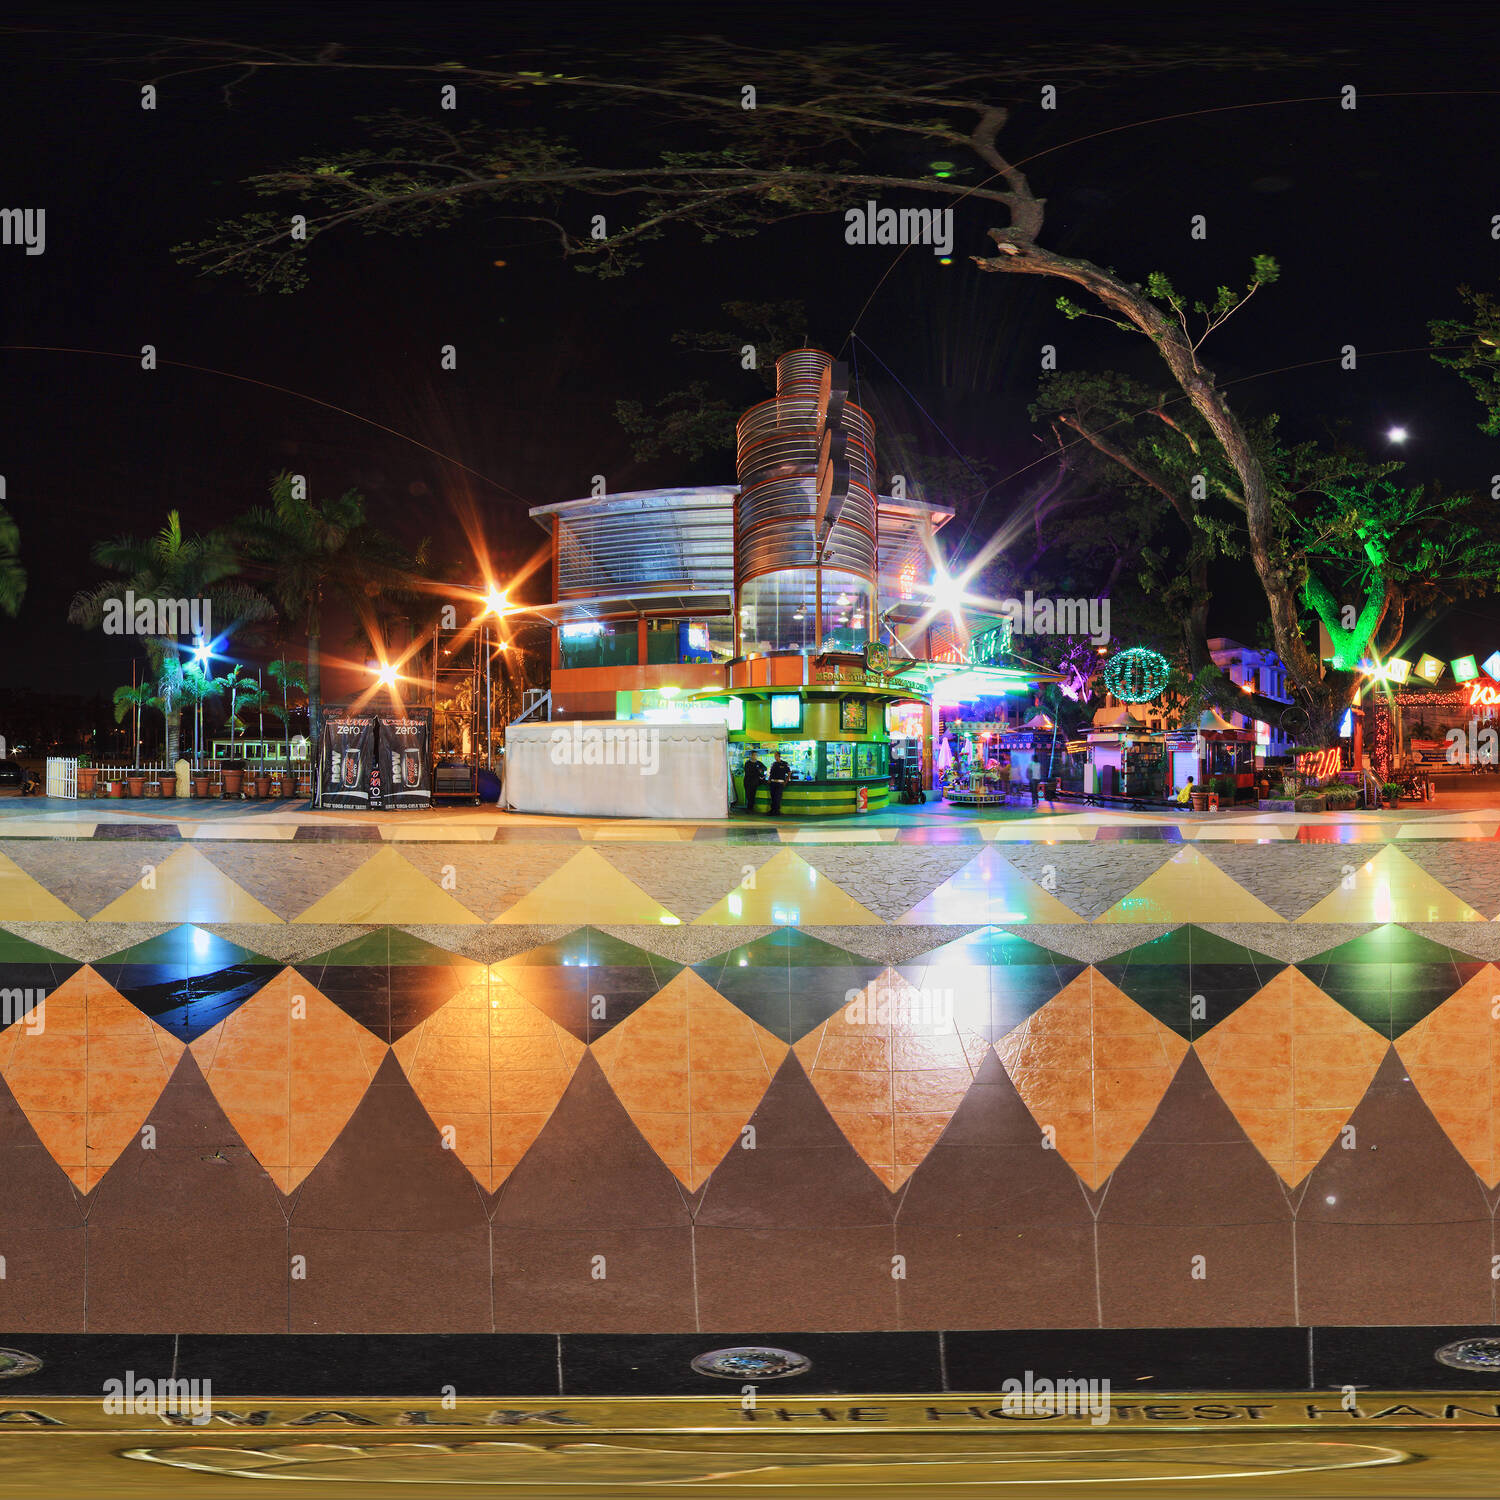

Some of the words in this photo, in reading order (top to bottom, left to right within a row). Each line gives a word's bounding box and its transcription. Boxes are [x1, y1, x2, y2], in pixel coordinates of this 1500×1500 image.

[337, 725, 360, 735] zero
[395, 725, 418, 735] zero
[331, 750, 341, 783] new
[391, 750, 401, 783] new
[156, 1409, 592, 1426] WALK
[724, 1407, 889, 1421] THE
[925, 1404, 1277, 1421] HOTTEST
